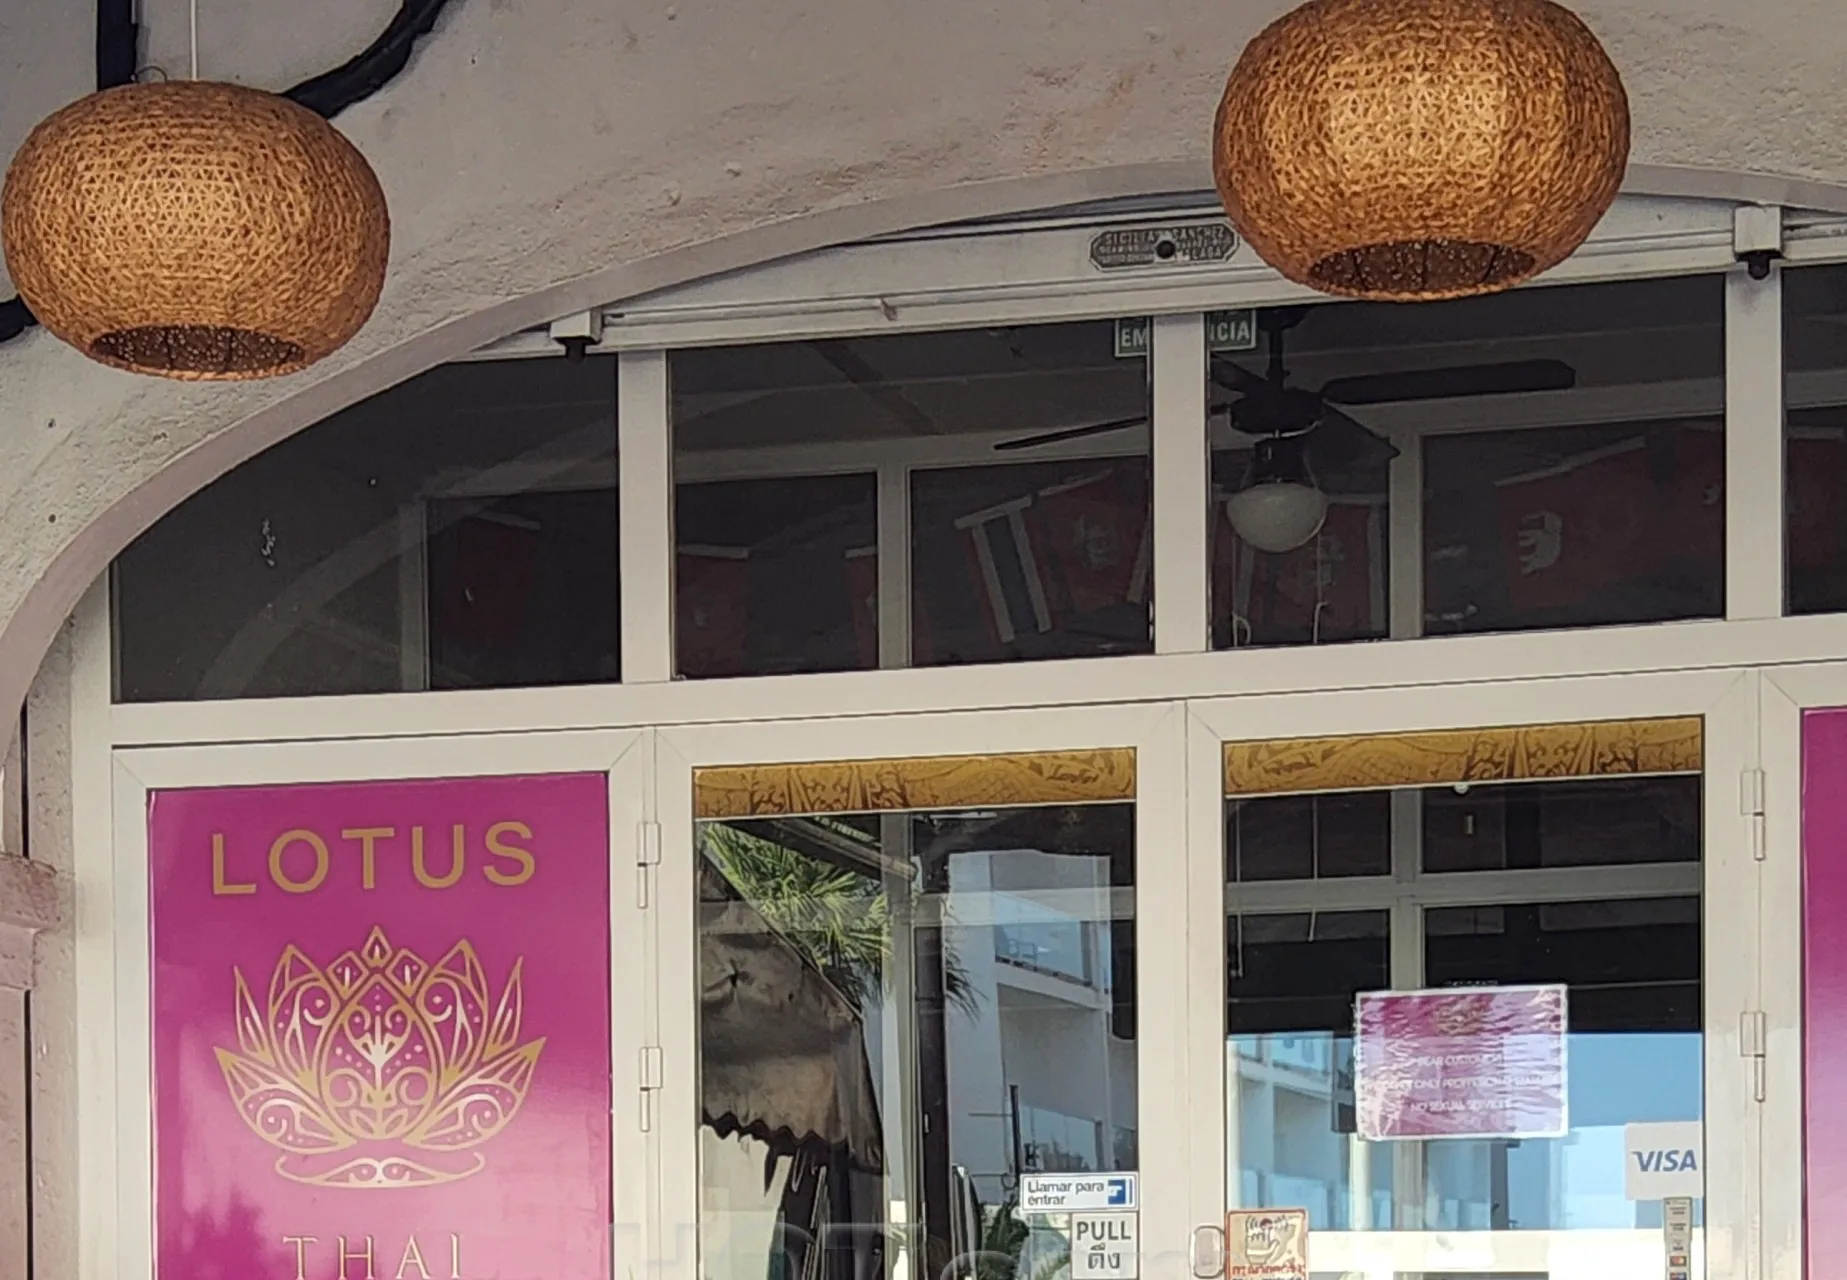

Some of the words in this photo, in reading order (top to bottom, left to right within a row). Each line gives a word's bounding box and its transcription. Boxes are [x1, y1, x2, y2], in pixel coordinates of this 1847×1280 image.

[212, 821, 536, 895] LOTUS
[1632, 1150, 1697, 1172] VISA
[1027, 1180, 1072, 1193] Llamar
[1075, 1182, 1104, 1195] para
[1028, 1194, 1065, 1206] entrar
[1076, 1220, 1132, 1241] PULL
